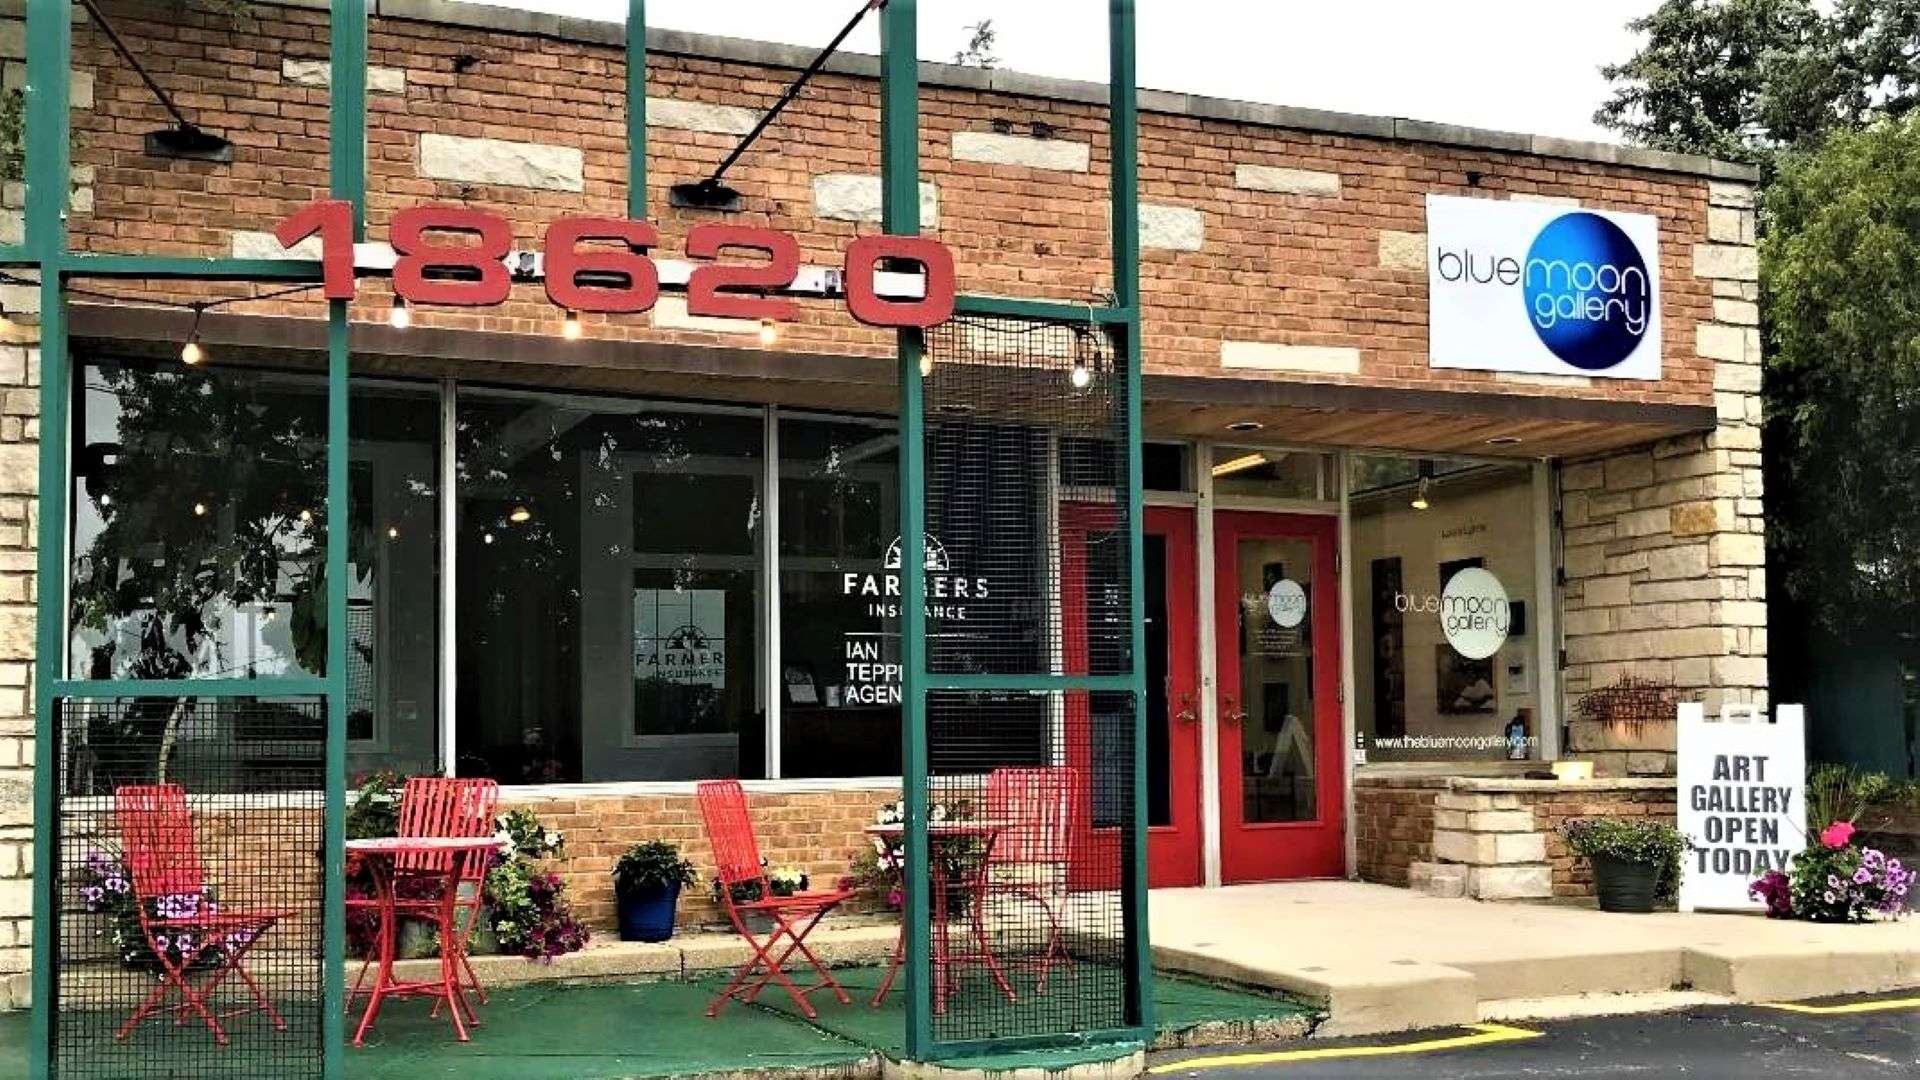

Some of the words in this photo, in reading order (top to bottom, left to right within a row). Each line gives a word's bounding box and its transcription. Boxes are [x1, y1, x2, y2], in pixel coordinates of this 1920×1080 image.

[274, 200, 956, 327] 18620
[1438, 247, 1520, 285] blue
[1526, 258, 1645, 296] moon
[1535, 292, 1645, 335] gallery
[843, 573, 989, 598] FARERS
[869, 603, 966, 620] INSANCE
[1394, 591, 1439, 612] blue
[1442, 596, 1508, 615] moon
[1447, 614, 1509, 638] gallery
[846, 641, 878, 660] IAN
[846, 685, 903, 703] AGEN
[1375, 735, 1538, 750] www.thebluemoongallery.com
[1712, 754, 1769, 782] ART
[1690, 785, 1793, 814] GALLERY
[1704, 816, 1779, 844] OPEN
[1693, 847, 1791, 876] TODAY
